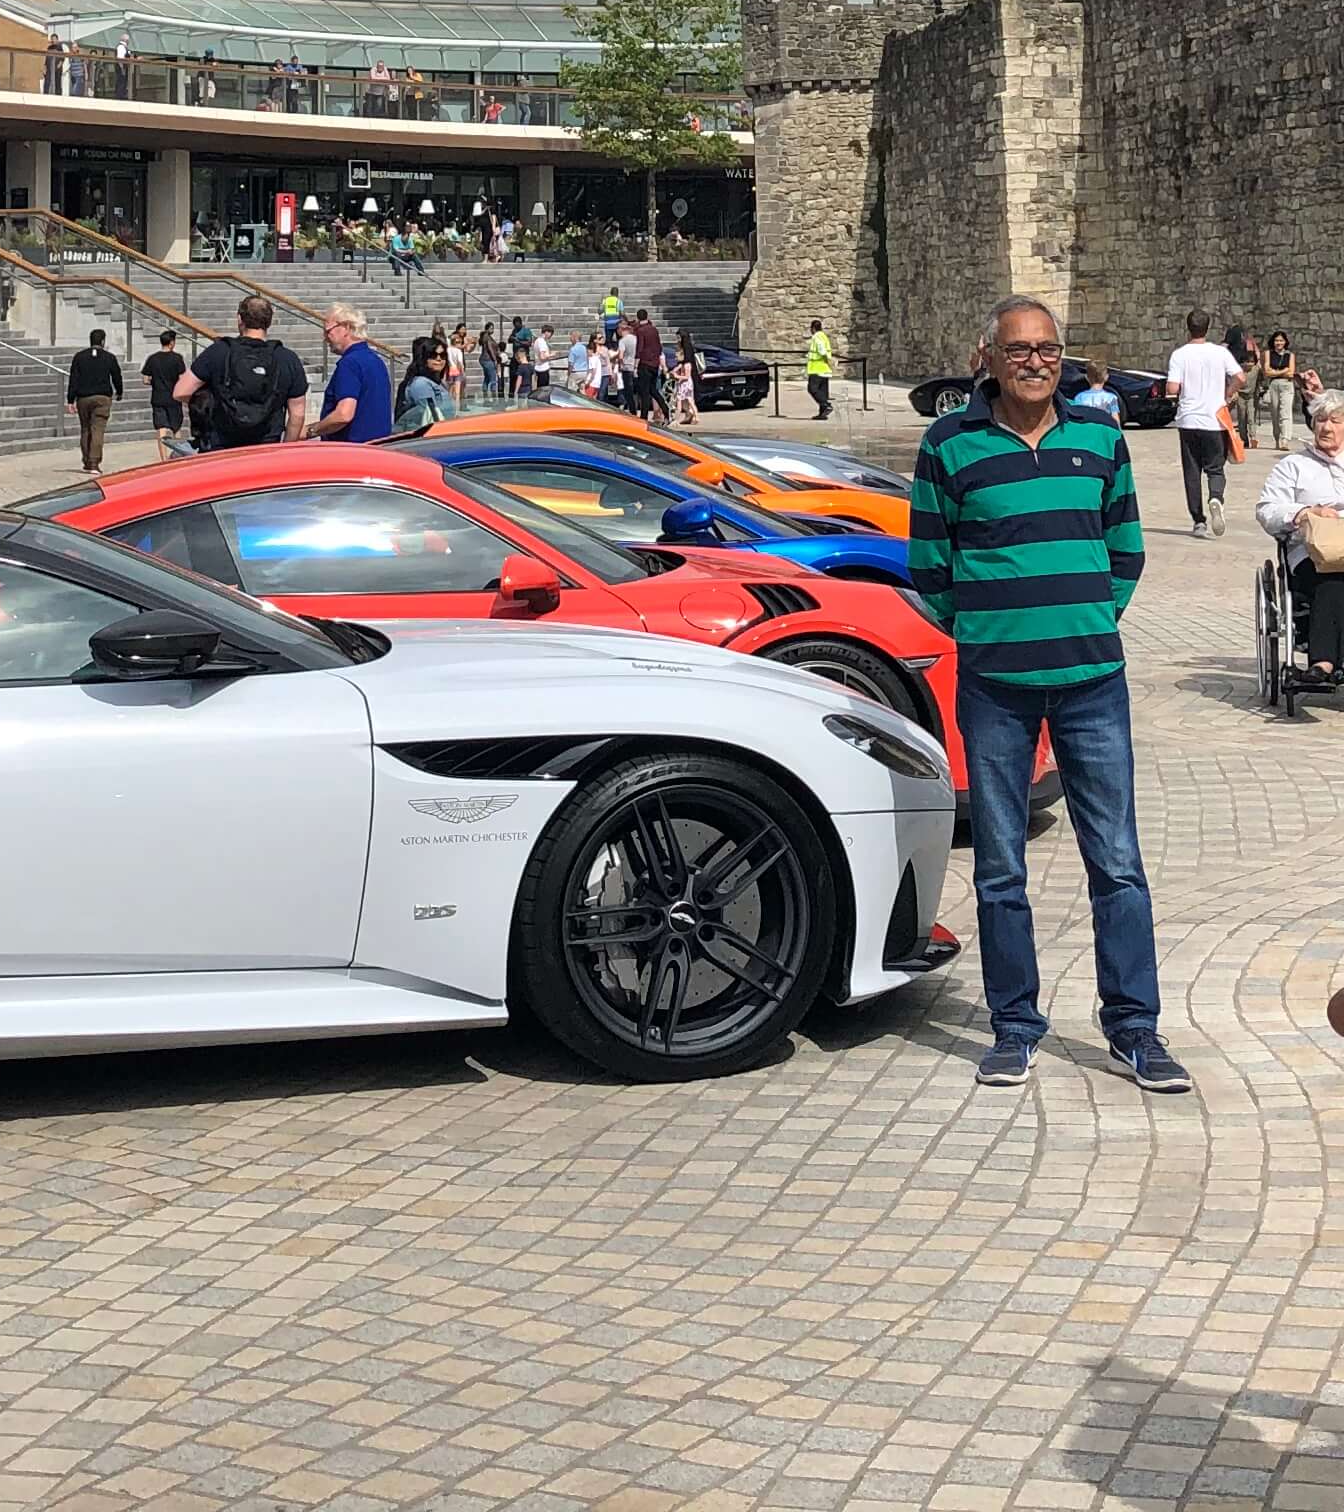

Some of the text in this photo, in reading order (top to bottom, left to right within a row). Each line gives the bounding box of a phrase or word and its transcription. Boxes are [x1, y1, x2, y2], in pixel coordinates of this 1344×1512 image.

[725, 168, 754, 179] WATE
[400, 831, 529, 846] ASTON MARTIN CHICHESTER
